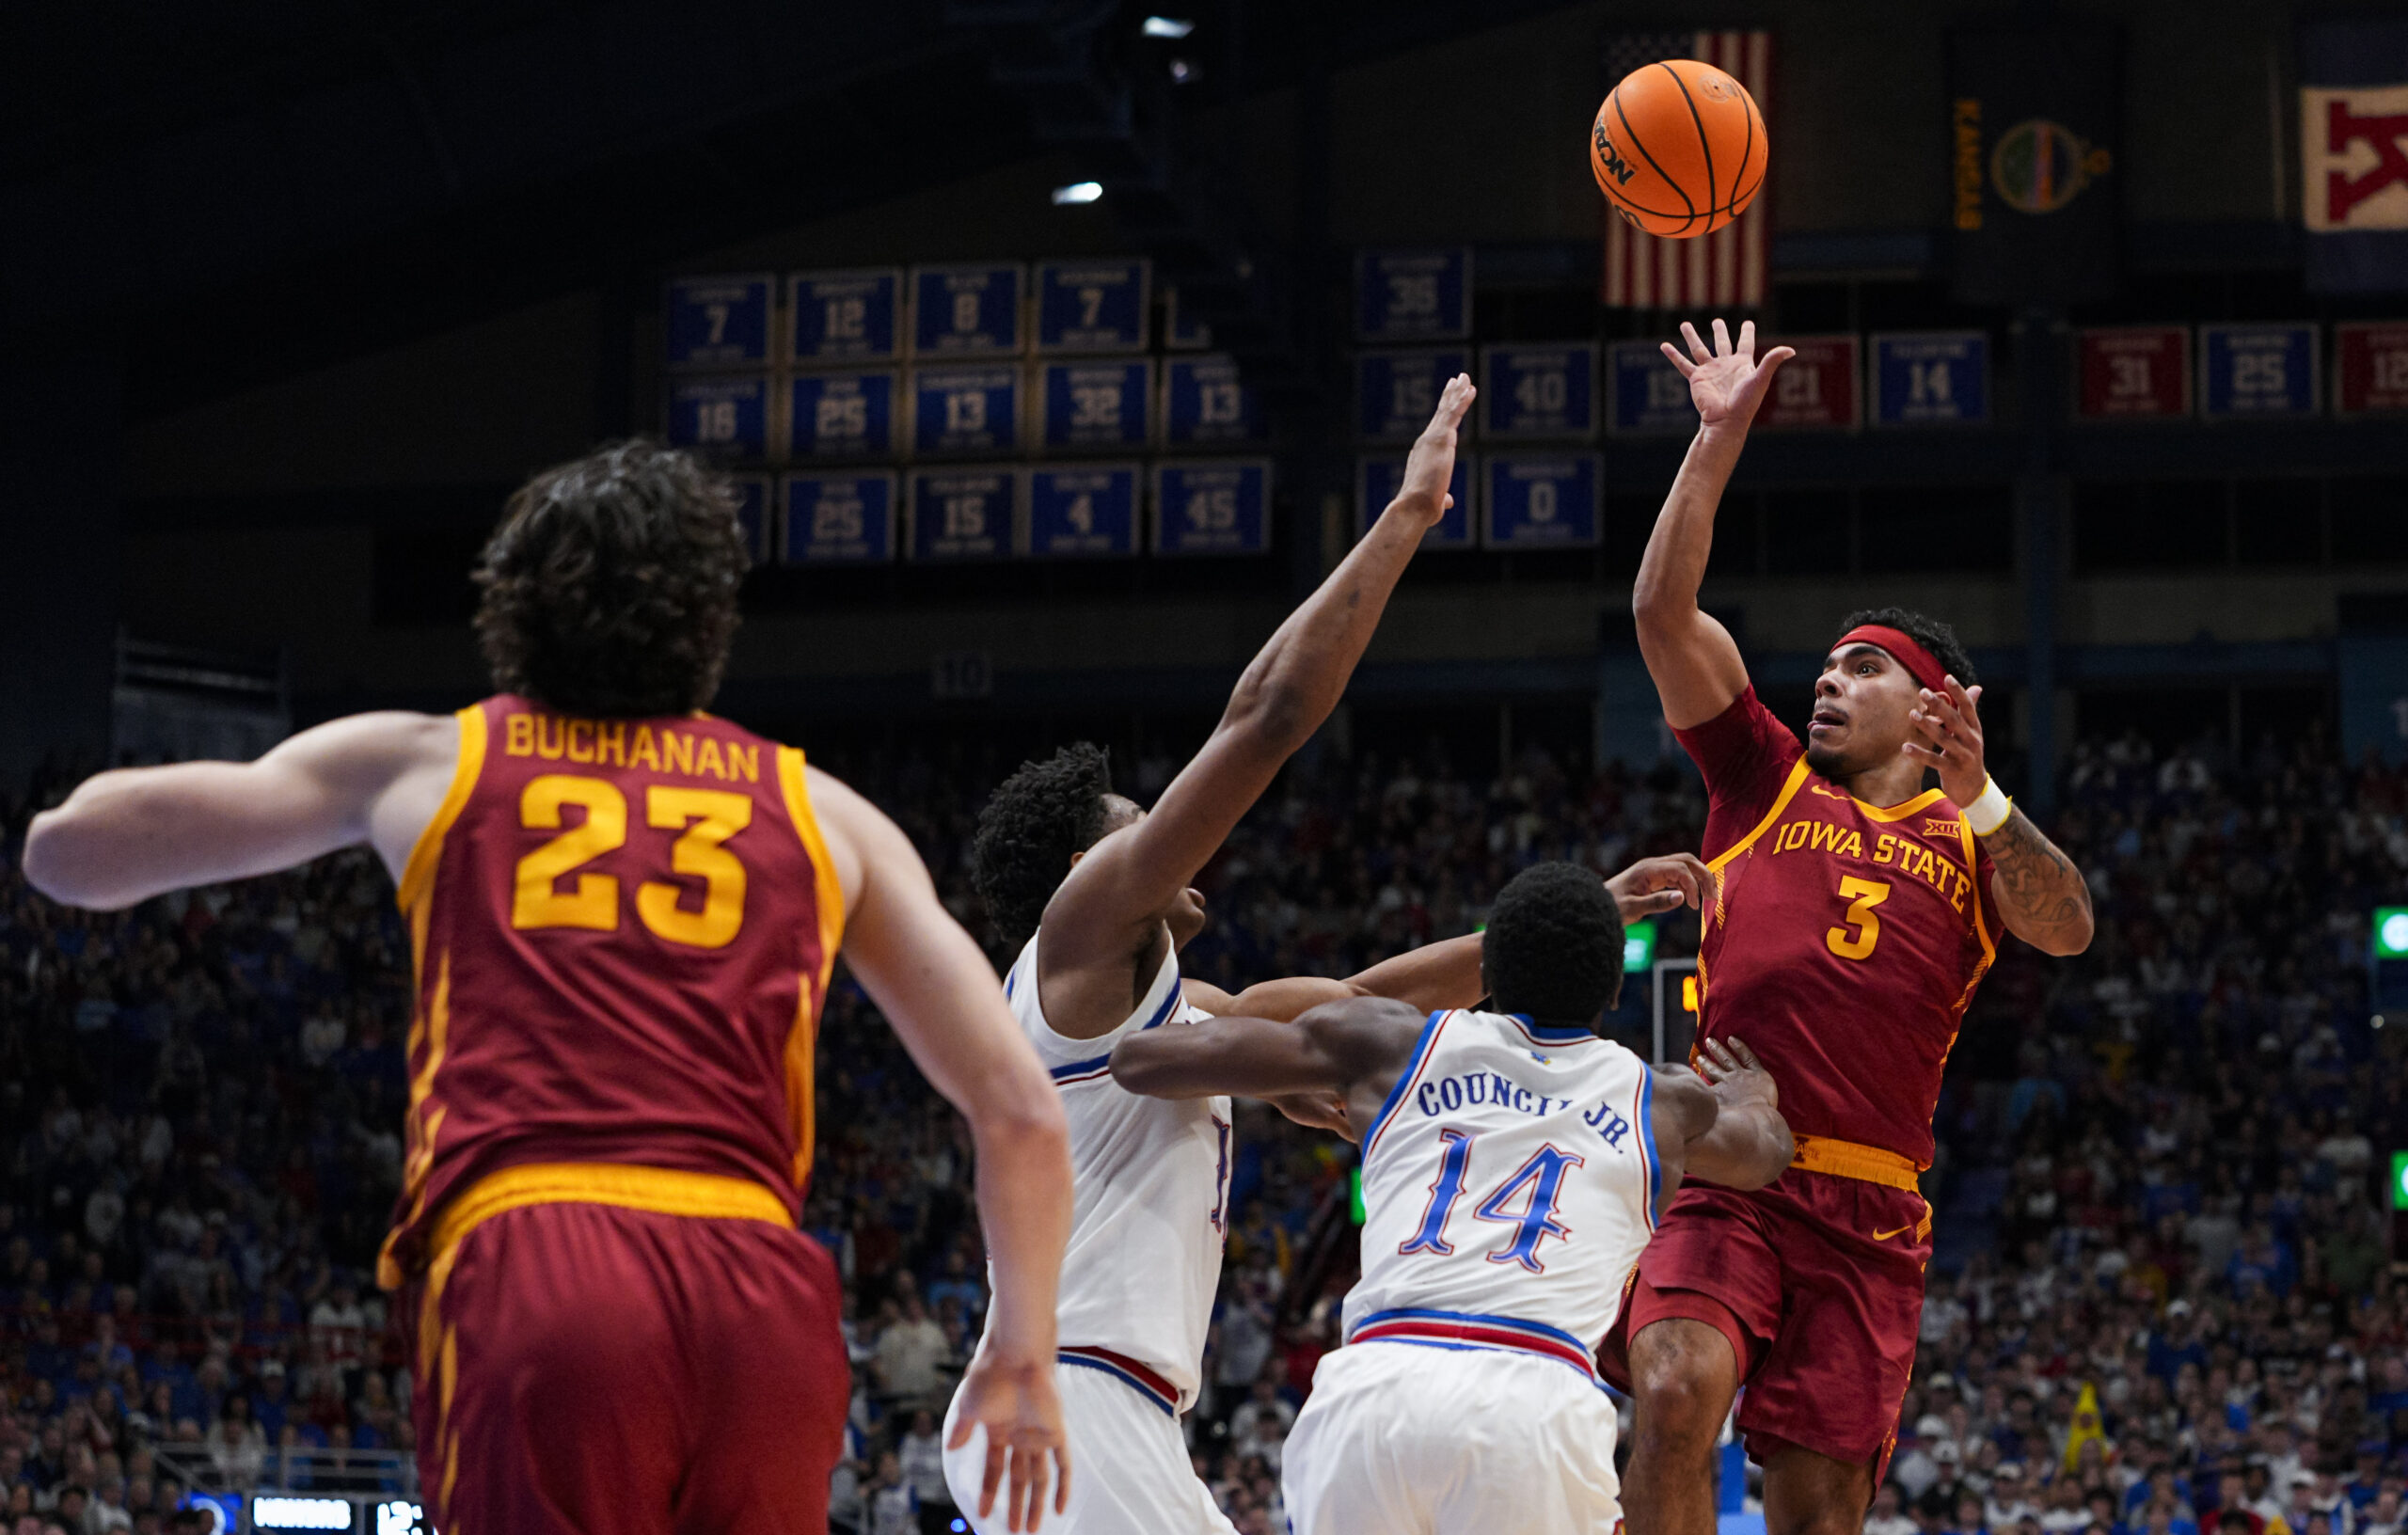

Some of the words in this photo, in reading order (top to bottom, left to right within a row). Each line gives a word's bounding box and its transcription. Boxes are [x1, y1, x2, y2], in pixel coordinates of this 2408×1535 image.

[705, 304, 728, 343] 7
[1078, 287, 1103, 326] 7
[1909, 362, 1953, 403] 14
[2108, 356, 2152, 396] 31
[945, 391, 987, 431] 13
[1070, 386, 1122, 426] 32
[1200, 384, 1243, 422] 13
[1068, 495, 1094, 533] 4
[1187, 489, 1236, 528] 45
[506, 713, 759, 783] BUCHANAN
[1928, 821, 1956, 834] XII
[512, 773, 752, 950] 23
[1772, 820, 1862, 859] IOWA
[1874, 833, 1972, 915] STATE
[1826, 875, 1891, 961] 3
[1583, 1101, 1629, 1154] JR.
[1399, 1128, 1585, 1274] 14
